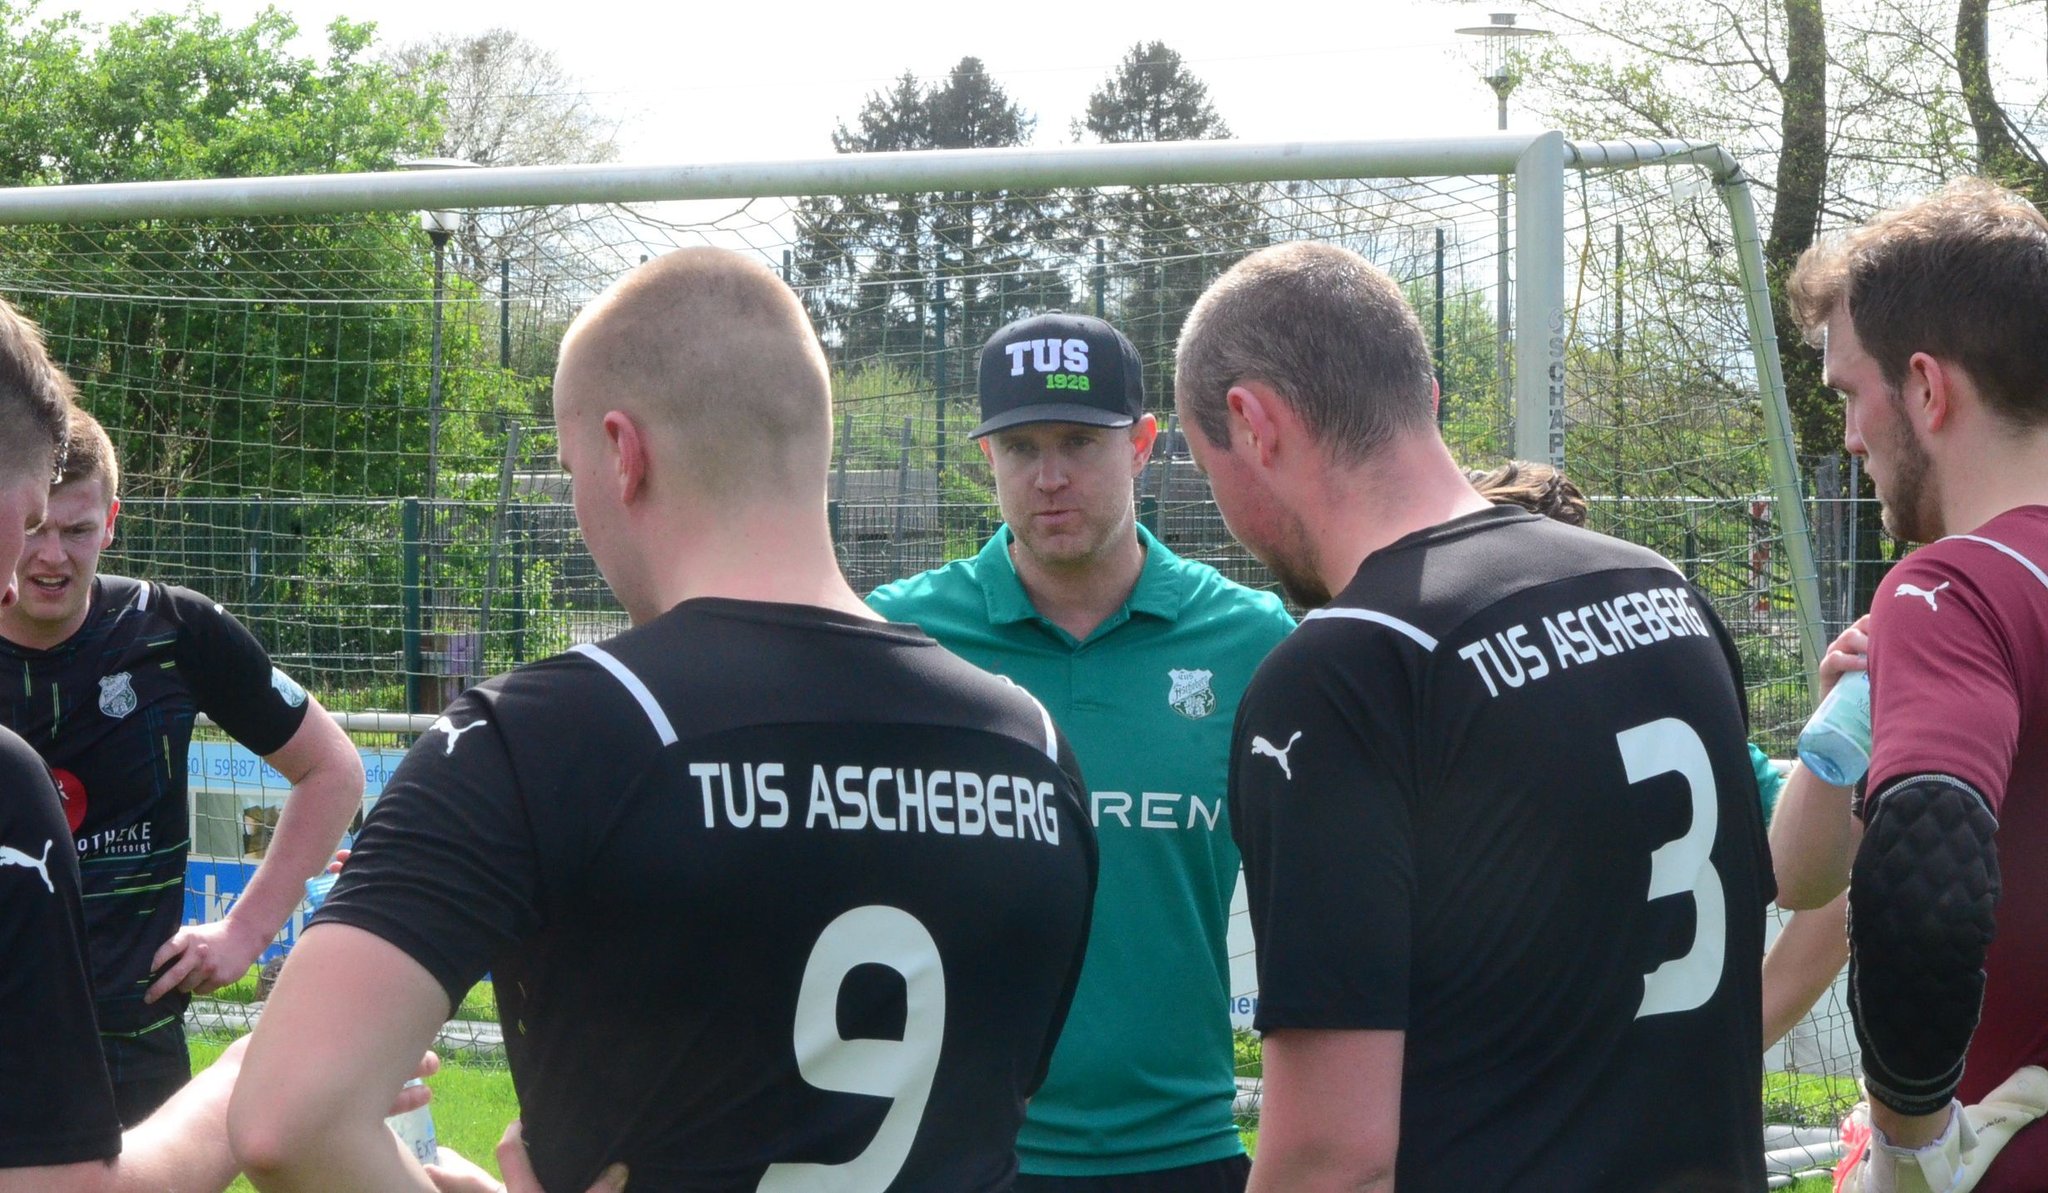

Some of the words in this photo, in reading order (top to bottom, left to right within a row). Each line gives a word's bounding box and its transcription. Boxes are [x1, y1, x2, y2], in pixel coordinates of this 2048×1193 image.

[1005, 338, 1089, 376] TUS
[1046, 373, 1090, 391] 1928
[1458, 624, 1549, 697] TUS
[1542, 587, 1709, 669] ASCHEBERG
[214, 758, 256, 777] 59387
[689, 763, 789, 828] TUS
[806, 764, 1059, 846] ASCHEBERG
[1091, 791, 1221, 831] REN
[104, 842, 151, 854] versorgt
[1617, 717, 1726, 1021] 3
[756, 905, 946, 1193] 9
